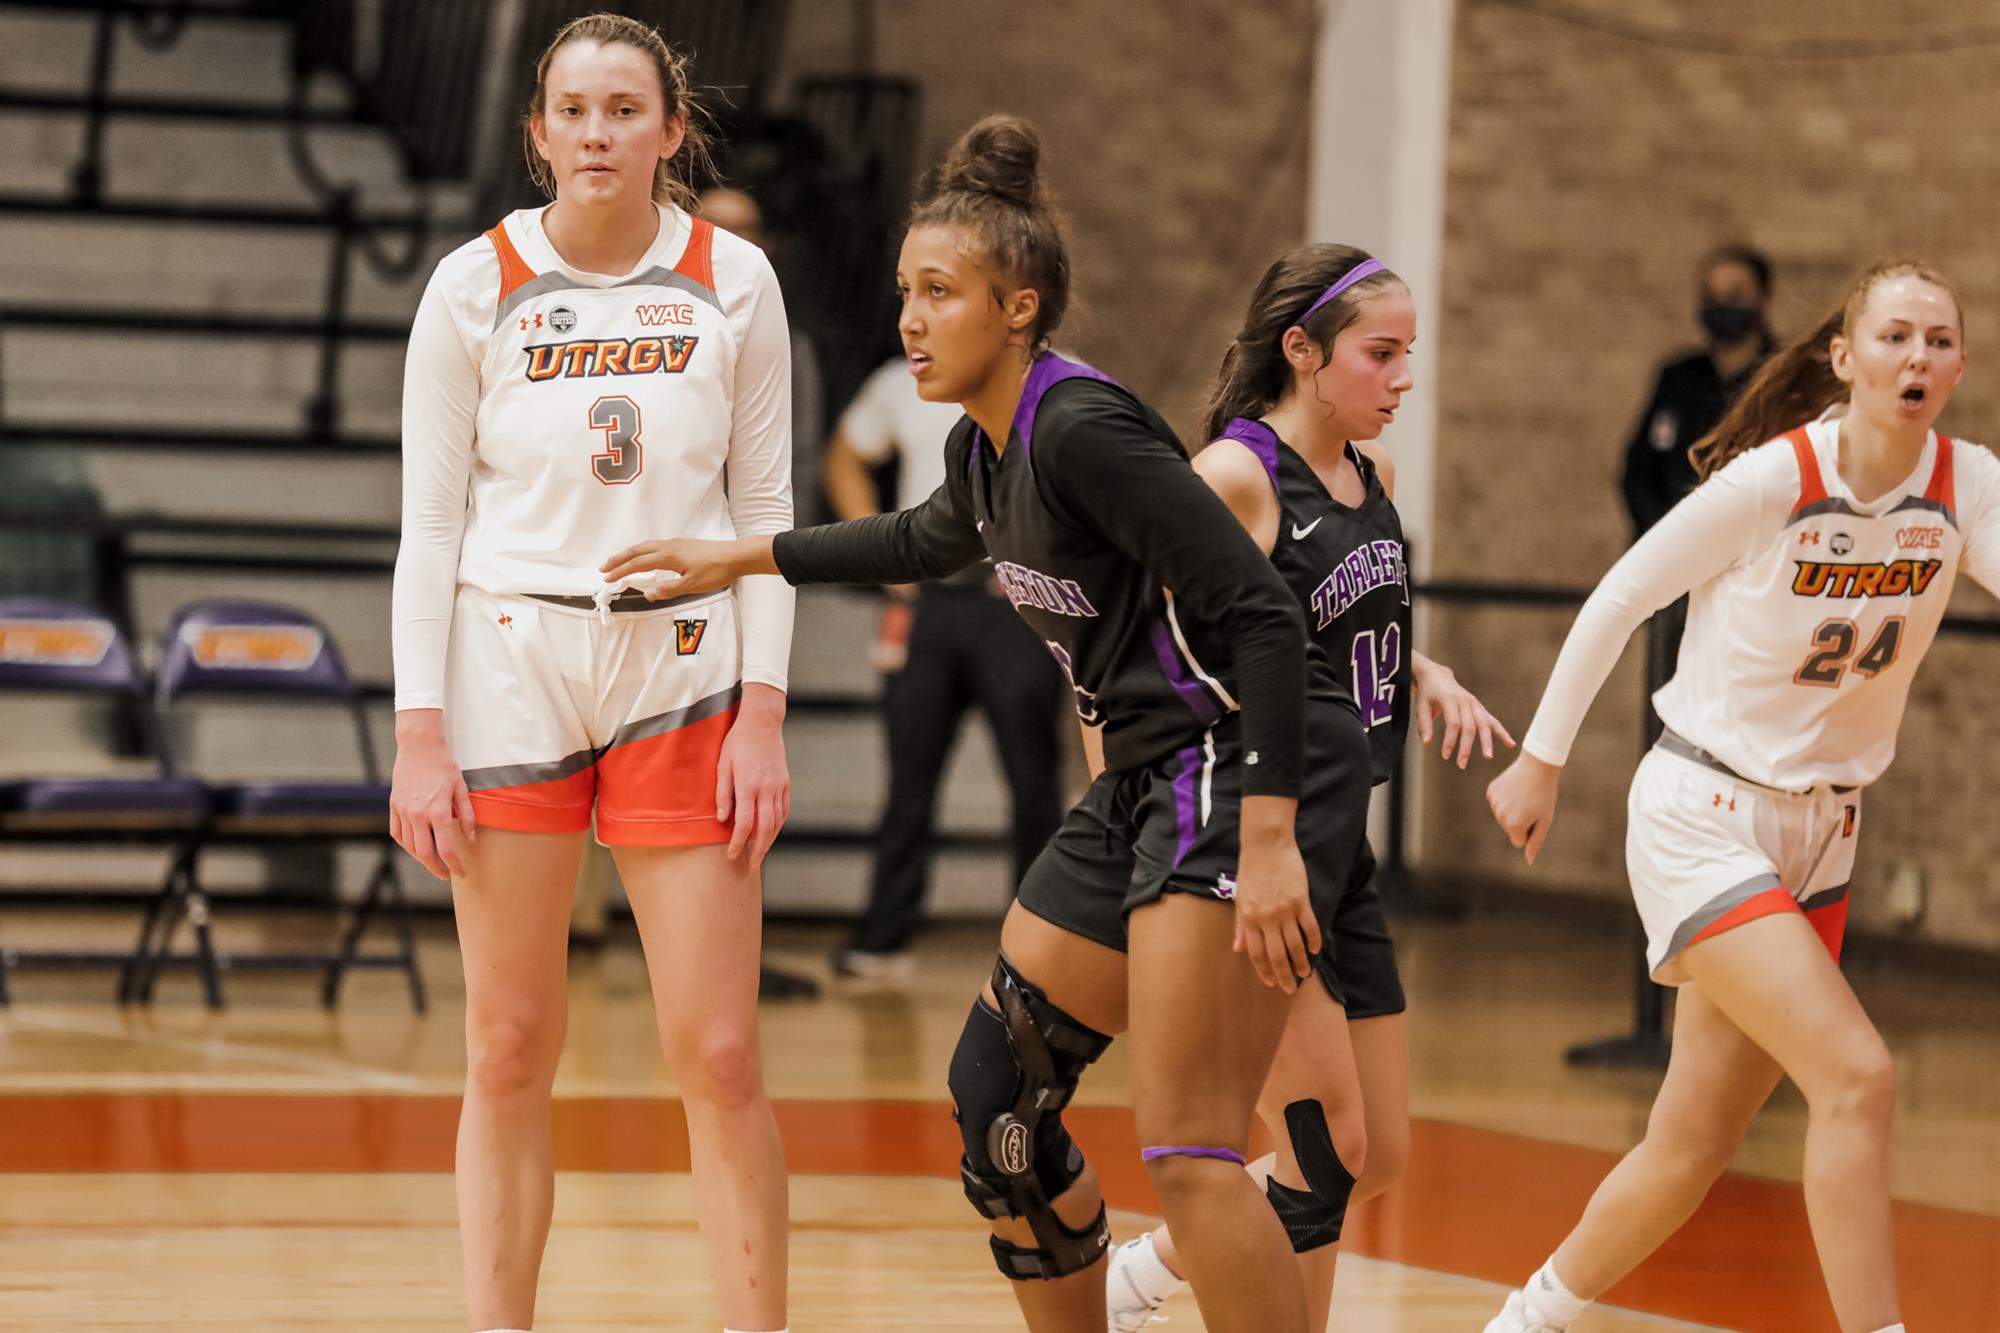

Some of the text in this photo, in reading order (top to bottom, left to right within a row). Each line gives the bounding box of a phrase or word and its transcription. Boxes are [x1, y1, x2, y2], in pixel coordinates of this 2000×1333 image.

[635, 304, 694, 326] WAC
[522, 335, 699, 382] UTRGV
[588, 395, 643, 485] 3
[1896, 527, 1944, 549] WAC
[1792, 559, 1942, 598] UTRGV
[1793, 615, 1906, 689] 24
[1351, 621, 1400, 733] 12
